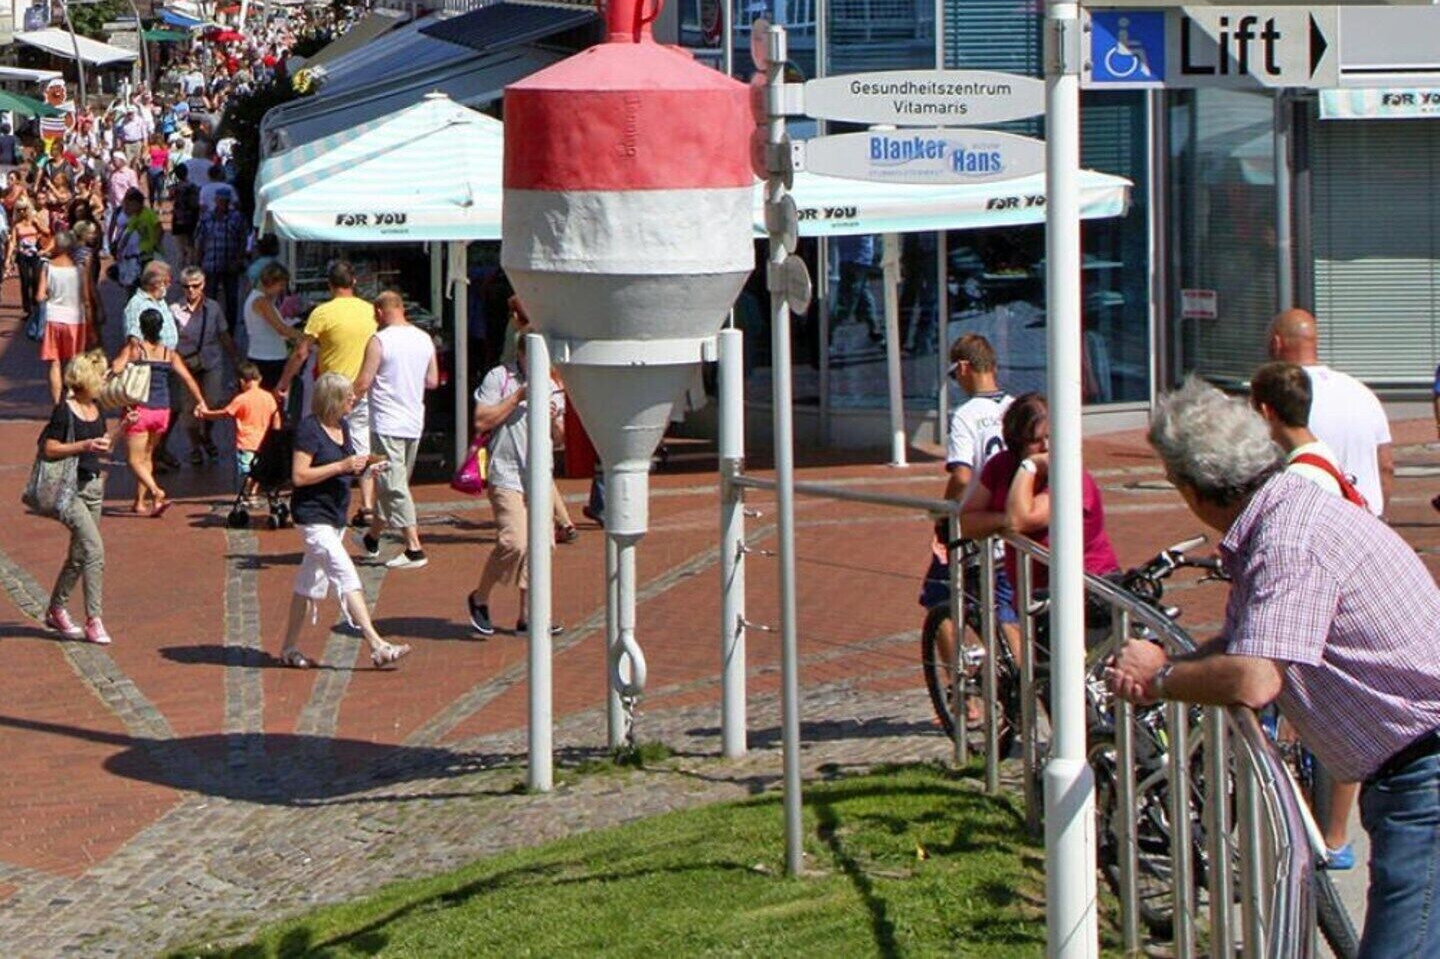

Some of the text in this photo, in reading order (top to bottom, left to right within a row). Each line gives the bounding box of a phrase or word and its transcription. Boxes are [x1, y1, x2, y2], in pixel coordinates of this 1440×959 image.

[1180, 15, 1281, 76] Lift
[850, 79, 1012, 96] Gesundheitszentrum
[893, 100, 968, 115] Vitamaris
[1381, 92, 1415, 107] FOR
[869, 136, 948, 160] Blanker
[952, 148, 1002, 173] Hans
[985, 194, 1048, 210] FOR YO
[335, 212, 408, 227] FOR YOU
[796, 206, 858, 221] OR YOU
